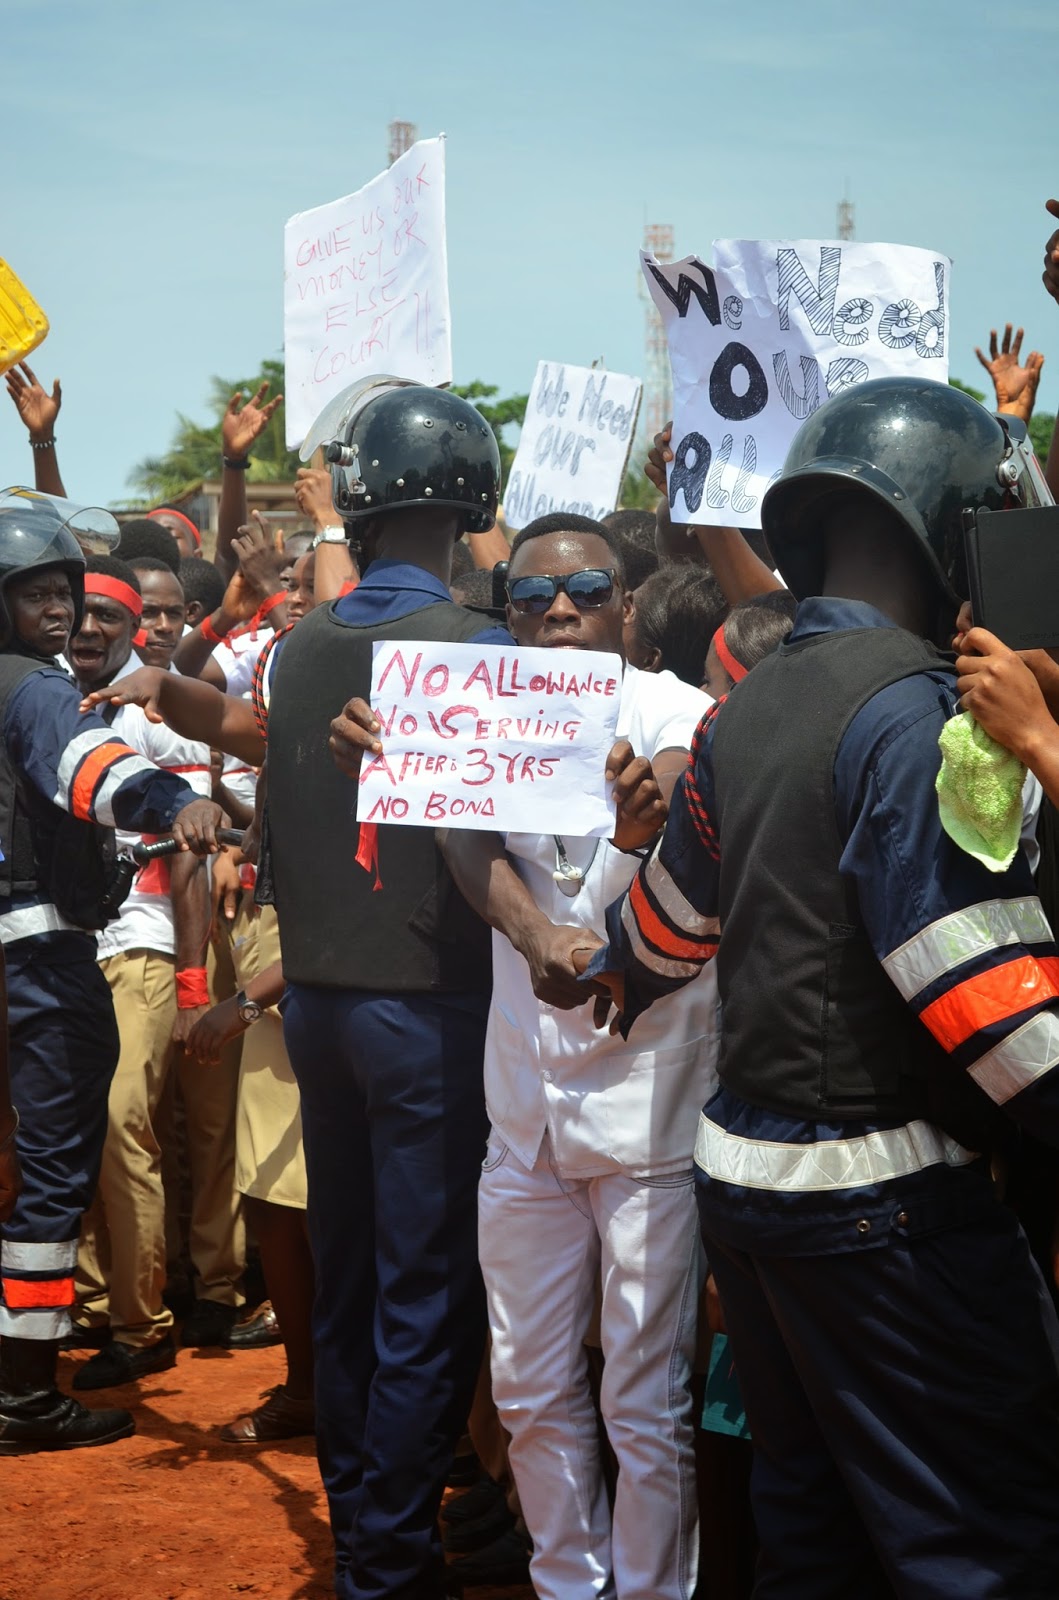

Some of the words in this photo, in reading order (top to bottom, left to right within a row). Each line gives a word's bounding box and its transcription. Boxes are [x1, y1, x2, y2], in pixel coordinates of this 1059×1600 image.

[296, 221, 354, 267] GIVE
[361, 206, 385, 235] US
[393, 212, 427, 256] OR
[325, 267, 398, 332] ELSE
[643, 258, 744, 331] We
[776, 246, 946, 359] Need
[536, 364, 570, 419] We
[577, 374, 640, 442] Need
[669, 431, 784, 514] ALL
[377, 649, 450, 698] NO
[462, 656, 617, 701] ALLOWANCE
[373, 704, 417, 738] NO
[461, 748, 496, 786] 3
[498, 752, 561, 785] YRS
[366, 795, 410, 821] NO
